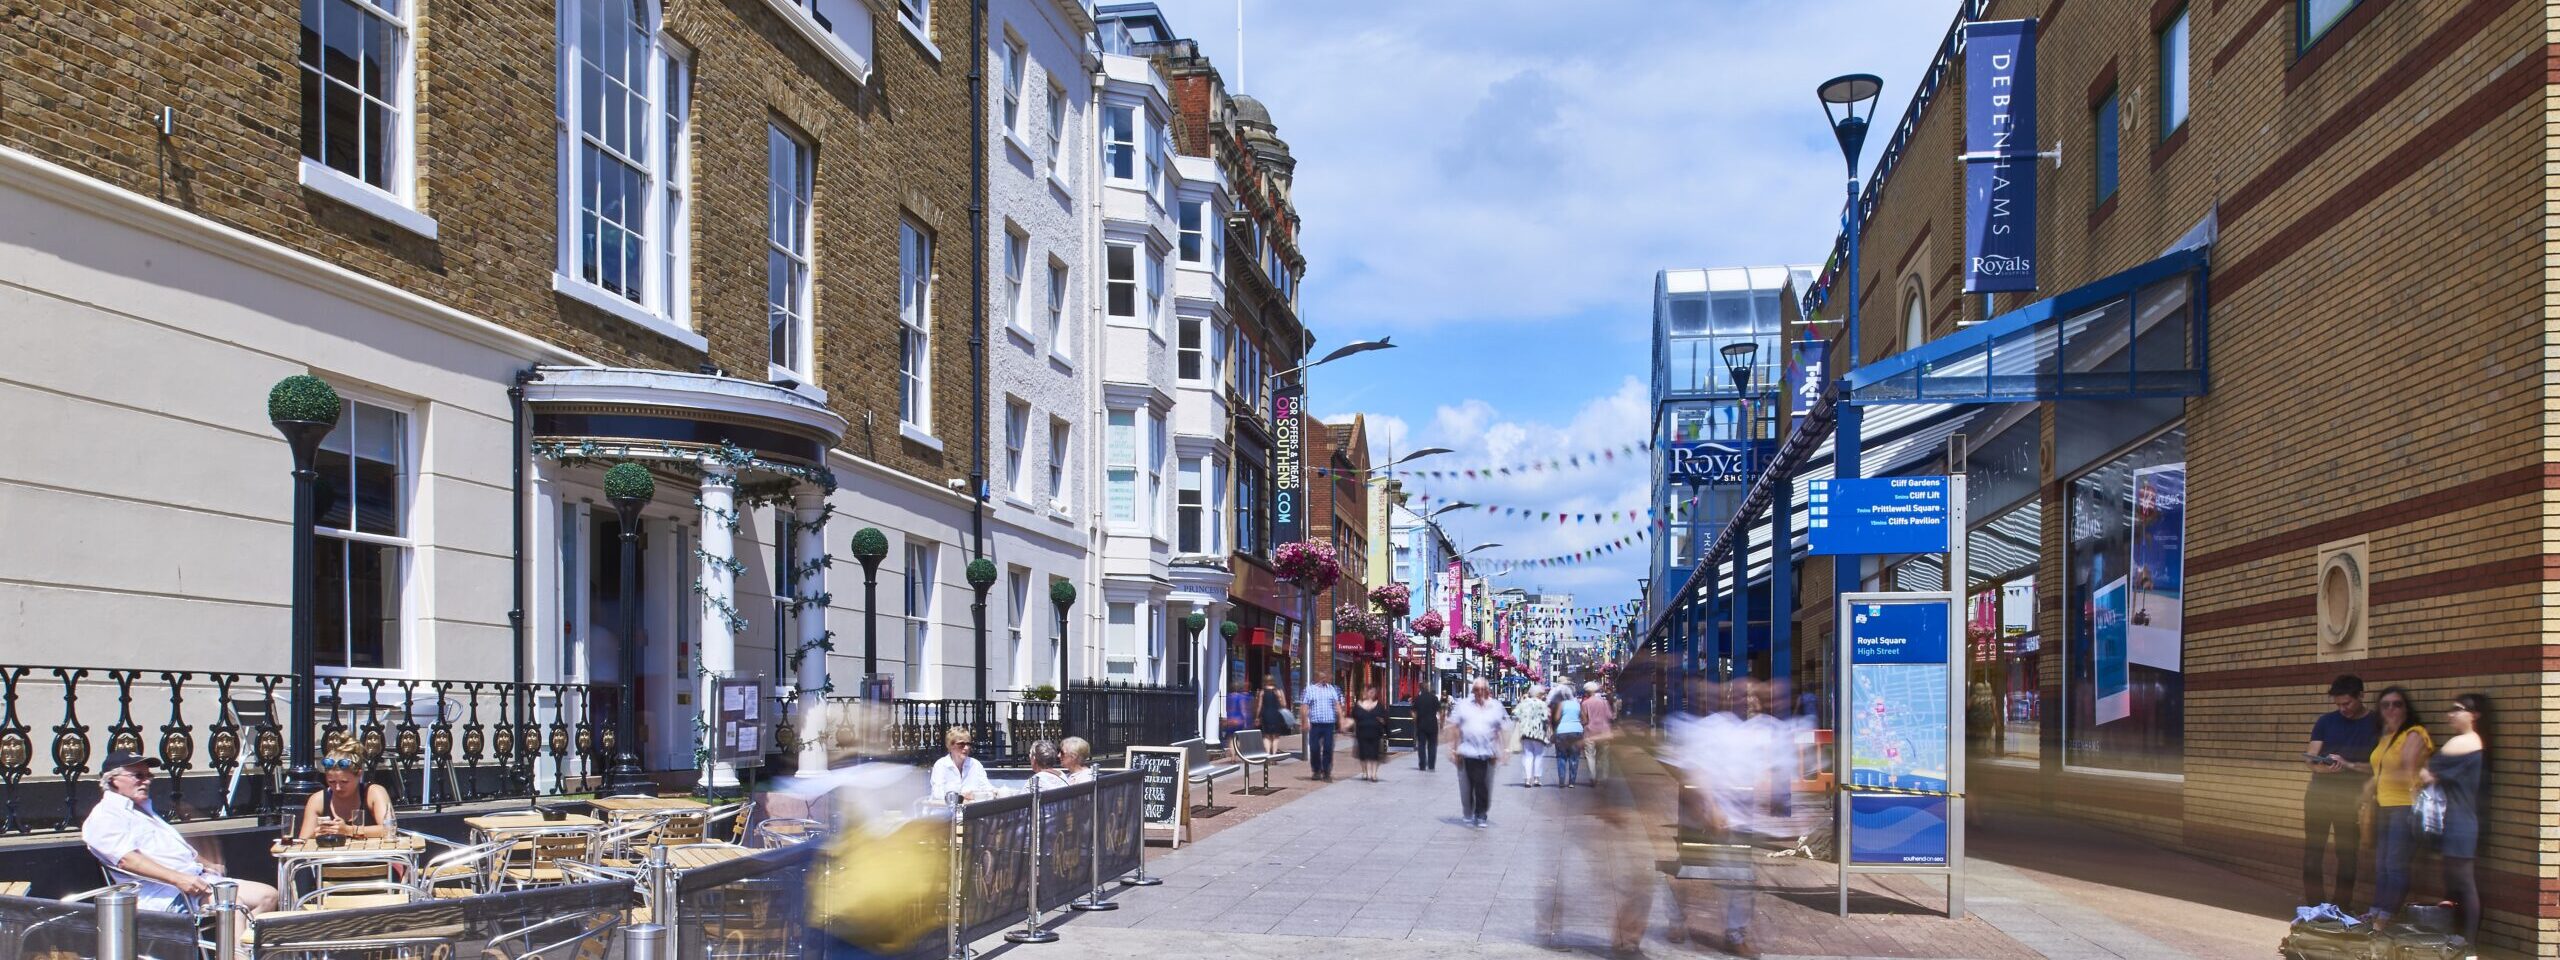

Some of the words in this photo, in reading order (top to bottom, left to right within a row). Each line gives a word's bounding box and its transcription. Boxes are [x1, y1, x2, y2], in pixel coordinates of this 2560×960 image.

[1992, 53, 2011, 235] DEBENHAMS
[1971, 255, 2030, 276] Royals
[1289, 396, 1298, 415] FOR
[1290, 419, 1299, 449] OFFERS
[1290, 460, 1299, 489] TREATS
[1891, 479, 1907, 487] Cliff
[1908, 479, 1940, 487] Gardens
[1909, 491, 1926, 499] Cliff
[1927, 491, 1940, 499] Lift
[1872, 505, 1911, 513] Prittlewell
[1913, 504, 1940, 514] Square
[1888, 517, 1909, 525] Cliffs
[1910, 516, 1940, 525] Pavilion
[1857, 637, 1878, 645] Royal
[1880, 637, 1906, 645] Square
[1857, 648, 1874, 656] High
